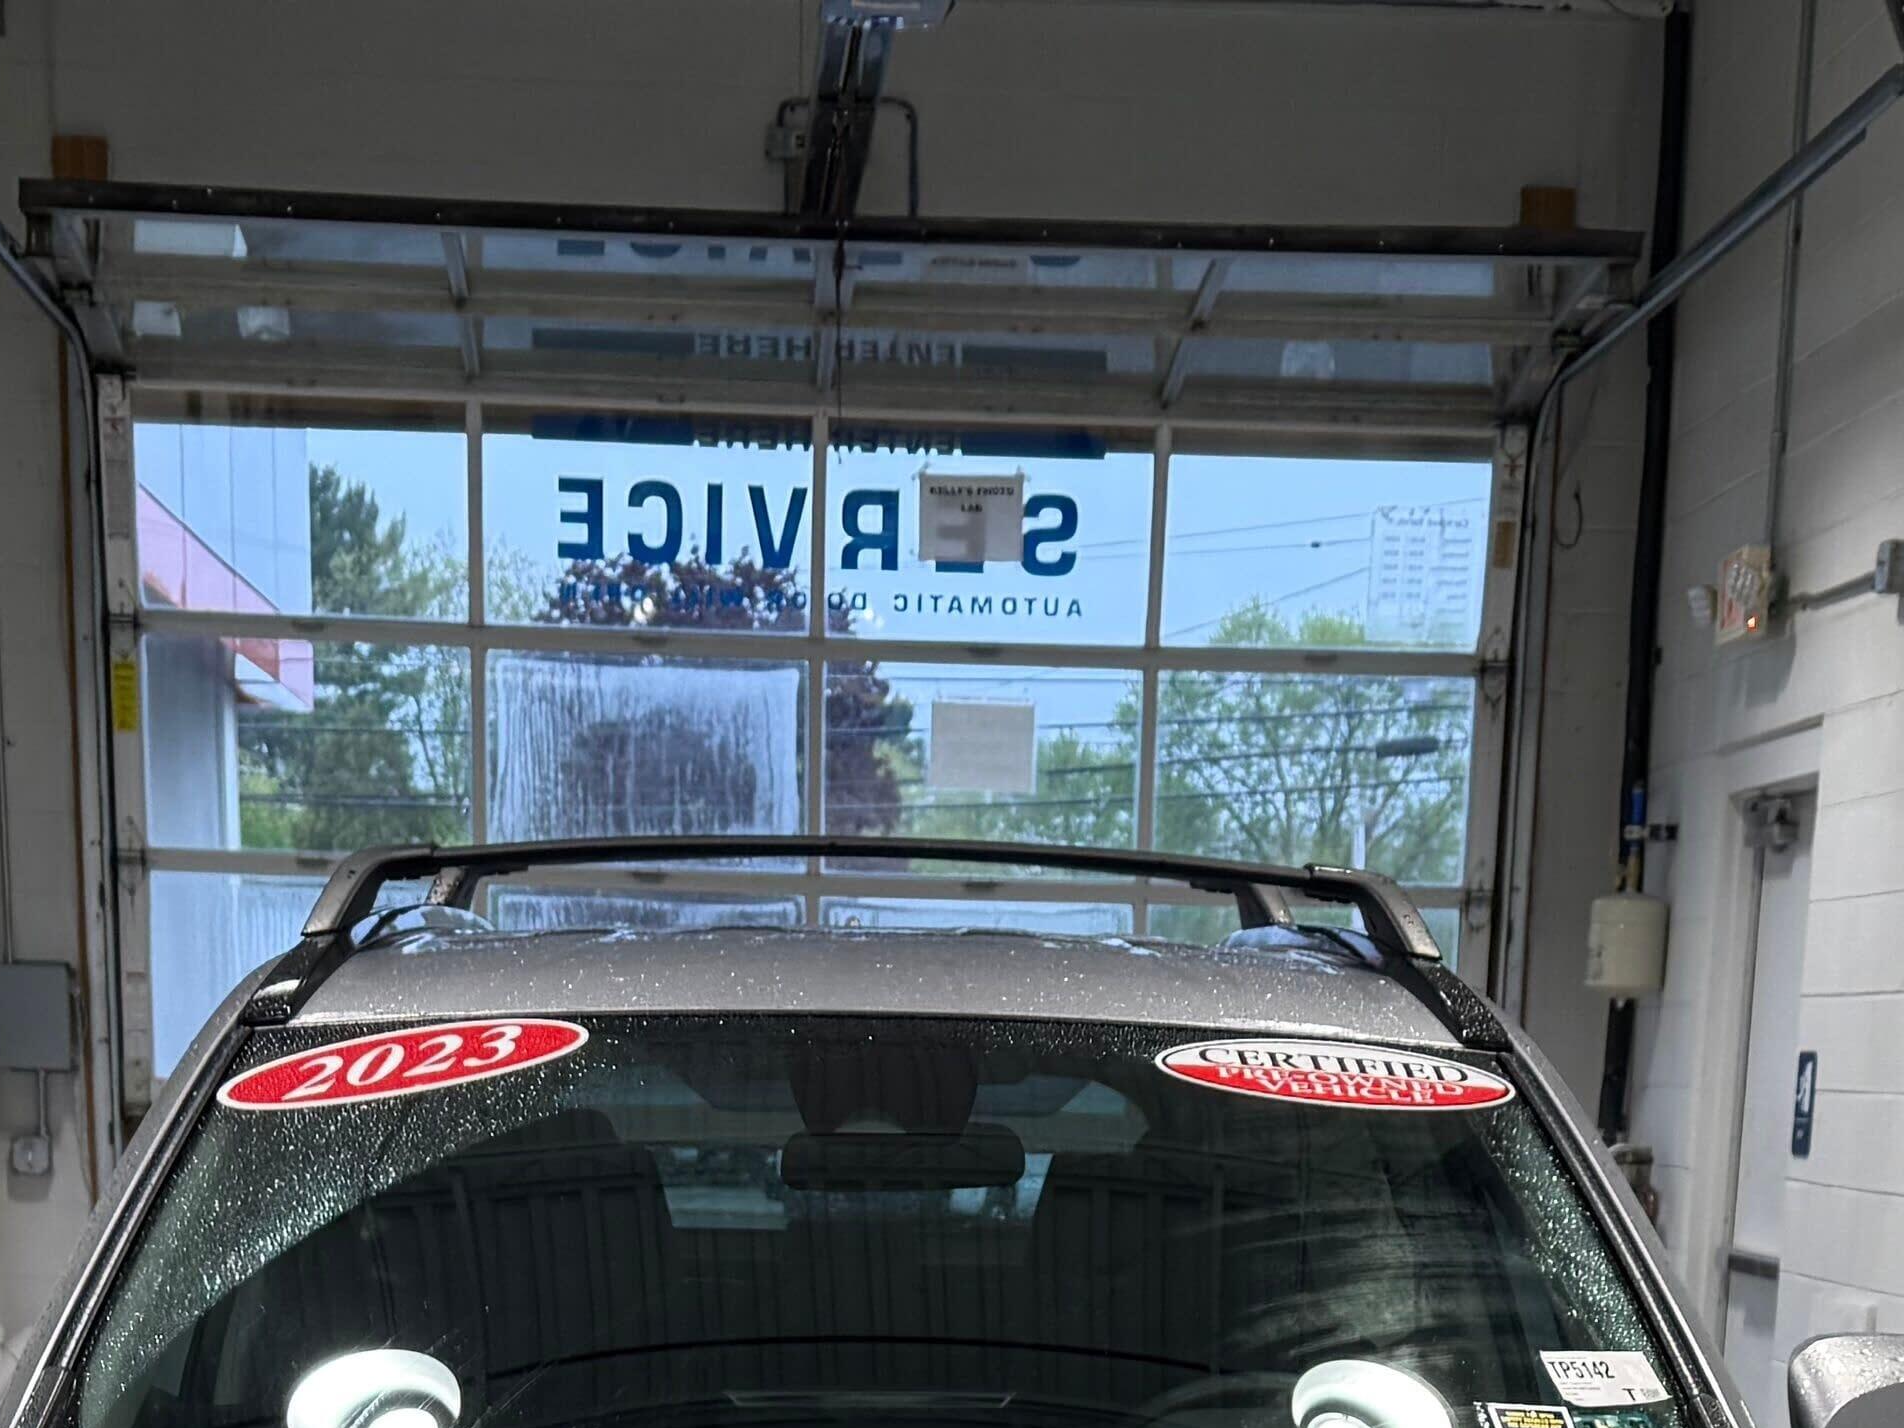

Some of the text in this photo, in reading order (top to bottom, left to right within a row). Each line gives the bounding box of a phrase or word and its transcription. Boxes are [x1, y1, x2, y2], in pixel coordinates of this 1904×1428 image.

[281, 1024, 524, 1101] 2023
[1199, 1047, 1469, 1084] CERTIFIED
[1219, 1065, 1464, 1096] PRE-OWNED
[1253, 1079, 1436, 1104] VEHICLE
[1547, 1360, 1615, 1379] TP5142
